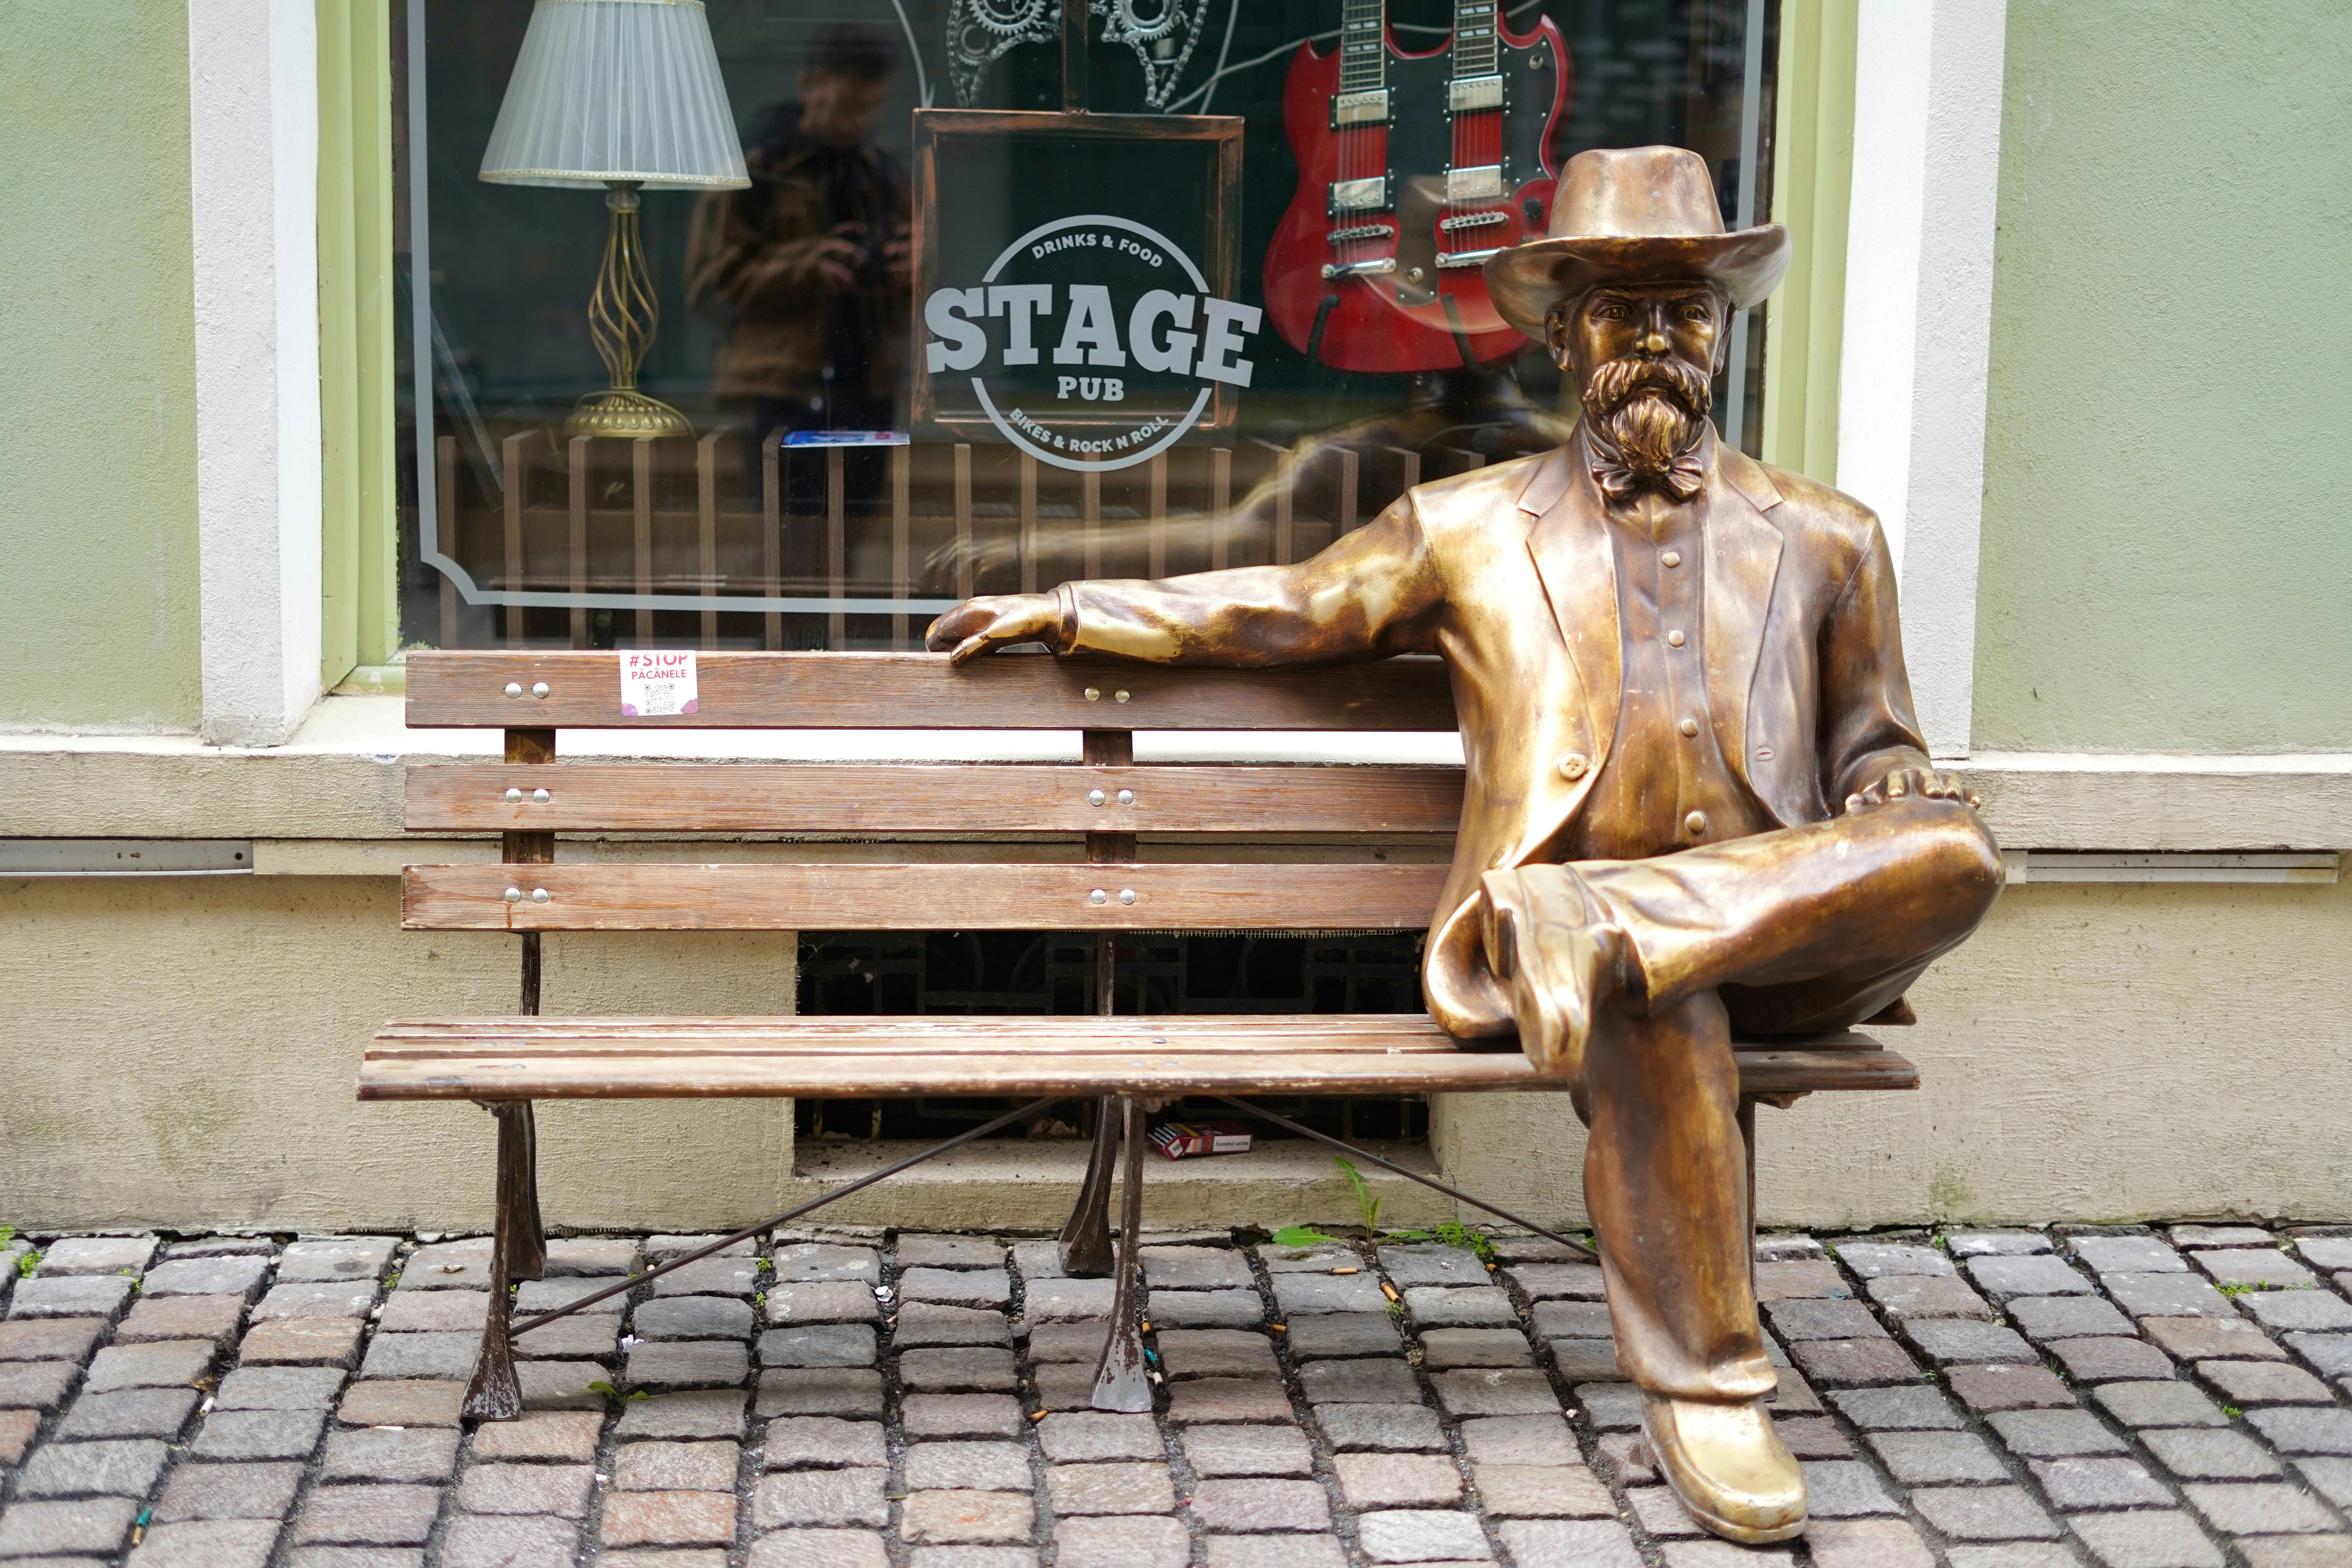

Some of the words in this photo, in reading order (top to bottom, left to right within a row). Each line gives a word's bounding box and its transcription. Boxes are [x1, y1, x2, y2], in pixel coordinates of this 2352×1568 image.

[1032, 234, 1097, 259] DRINKS
[1102, 235, 1113, 248] &
[1119, 239, 1163, 267] FOOD
[924, 284, 1263, 388] STAGE
[1057, 376, 1124, 401] PUB
[1009, 408, 1052, 443] BIKES
[1053, 436, 1064, 449] &
[1069, 439, 1114, 453] ROCK
[1116, 436, 1129, 450] N
[1130, 416, 1169, 444] ROLL
[629, 653, 688, 667] #STOP
[632, 668, 686, 679] PĂCĂNELE
